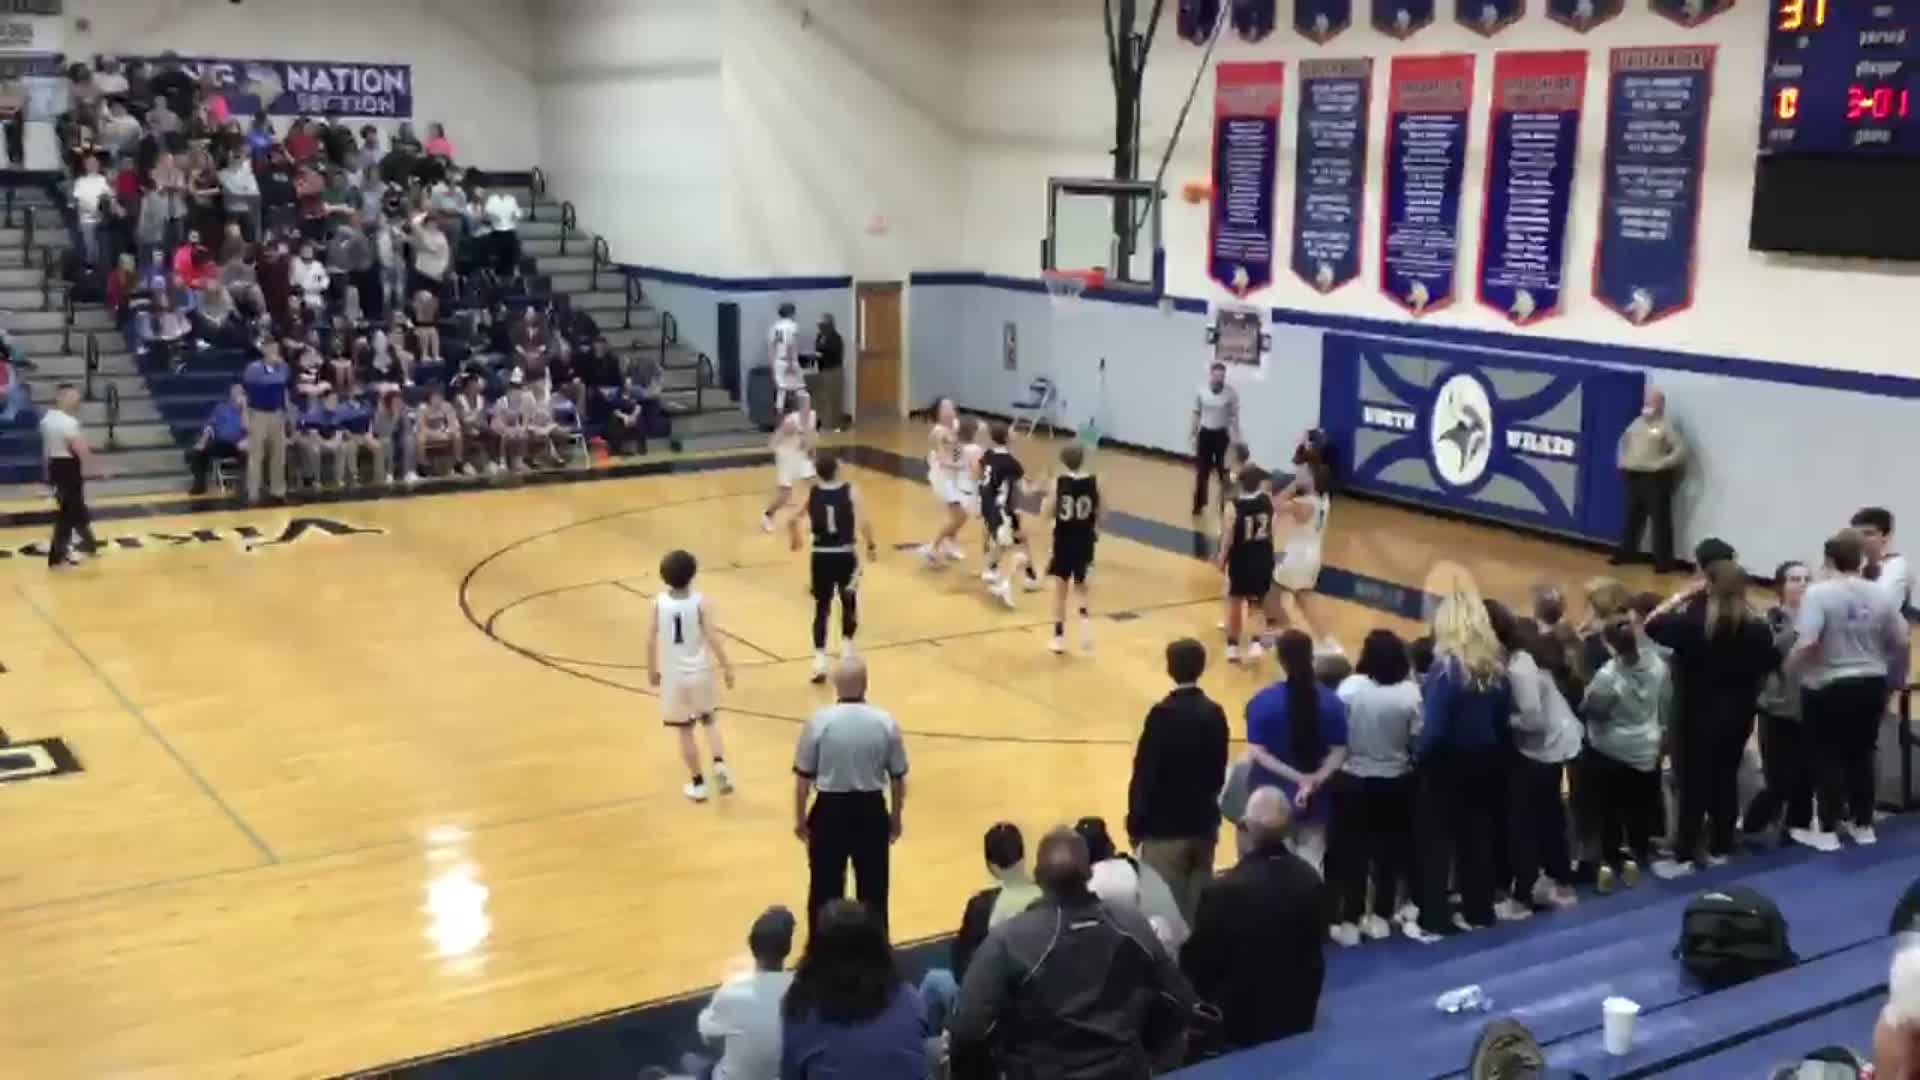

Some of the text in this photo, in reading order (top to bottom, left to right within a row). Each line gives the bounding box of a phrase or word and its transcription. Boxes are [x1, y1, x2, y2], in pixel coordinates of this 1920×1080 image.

[287, 65, 405, 94] NATION
[824, 504, 838, 533] 1
[1059, 493, 1093, 521] 30
[1243, 512, 1271, 541] 12
[672, 610, 685, 645] 1
